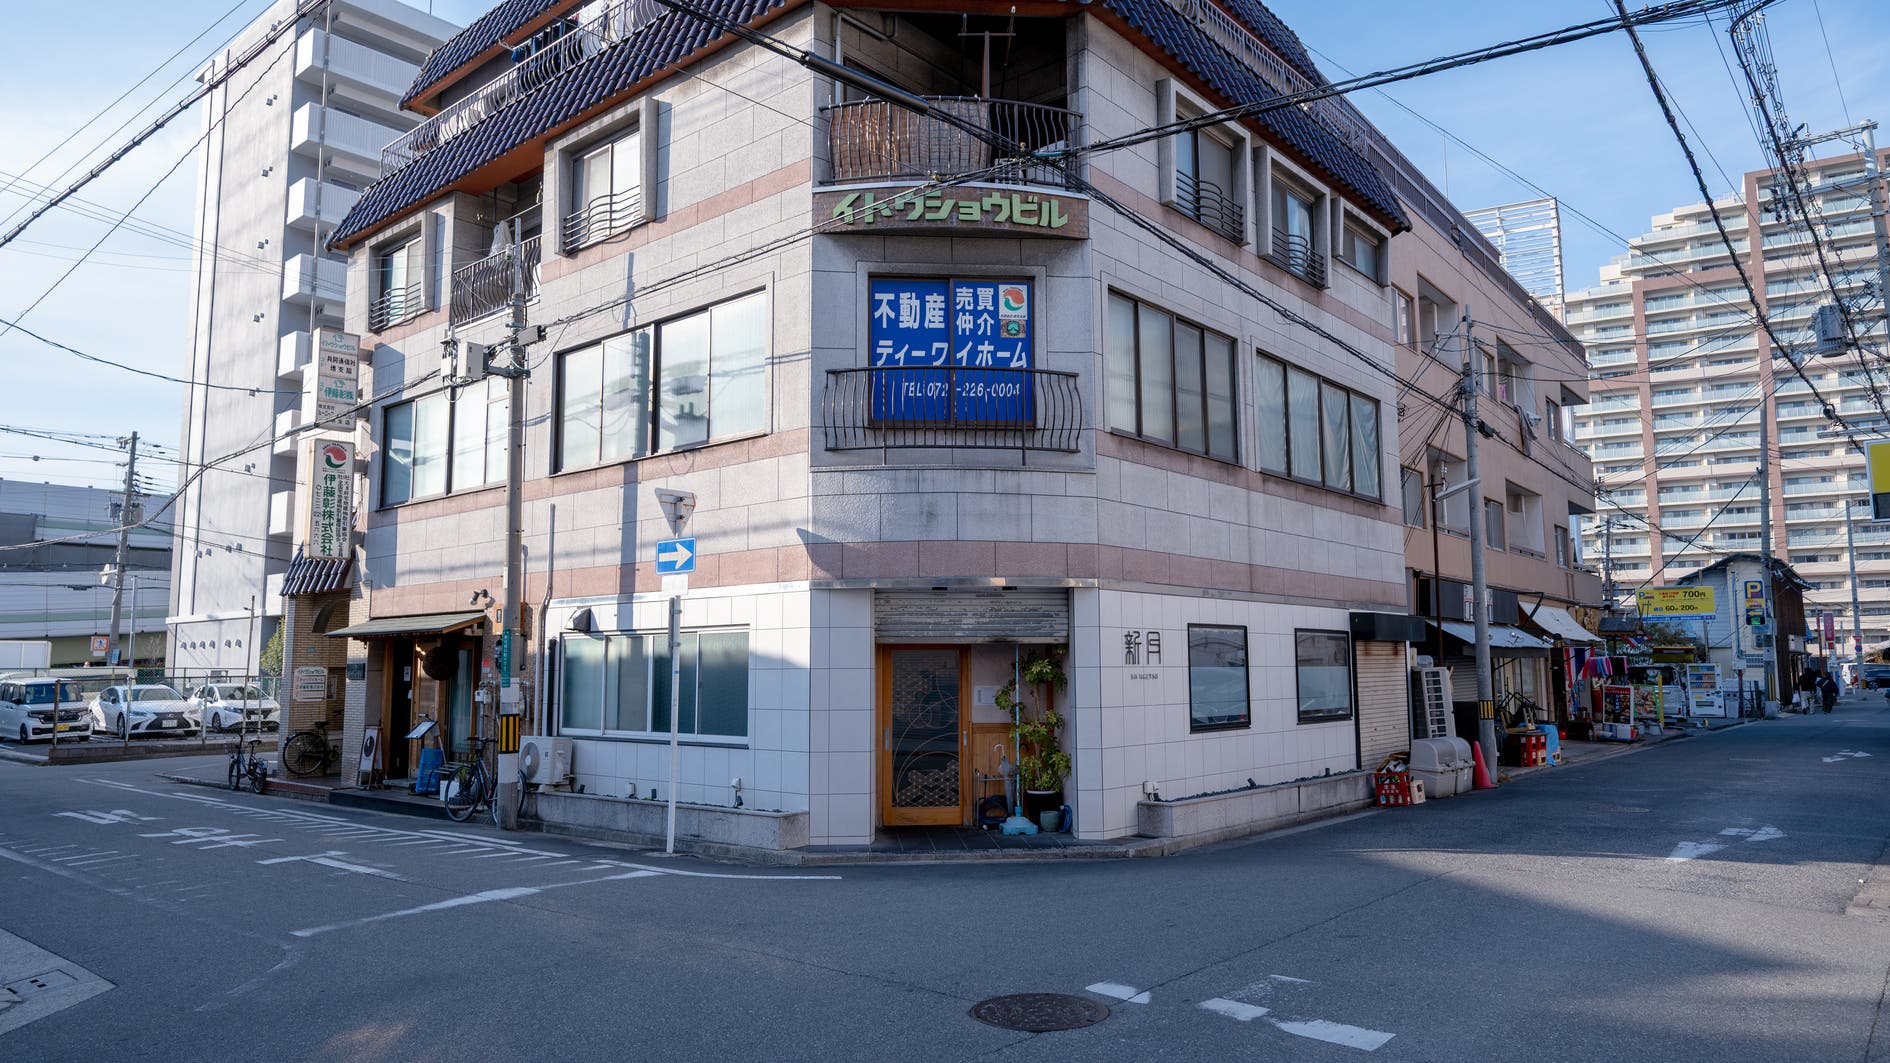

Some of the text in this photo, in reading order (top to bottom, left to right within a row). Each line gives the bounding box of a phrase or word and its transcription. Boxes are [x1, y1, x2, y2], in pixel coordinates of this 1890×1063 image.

[832, 192, 1068, 229] イトウショウビル
[873, 292, 946, 330] 不動産
[955, 287, 994, 312] 売買
[955, 312, 995, 336] 仲介
[875, 340, 1028, 369] ティーワイホーム
[320, 473, 336, 557] 伊藤彰株式会社
[1682, 590, 1706, 598] 700円
[1746, 582, 1762, 599] P
[1123, 631, 1162, 665] 新月
